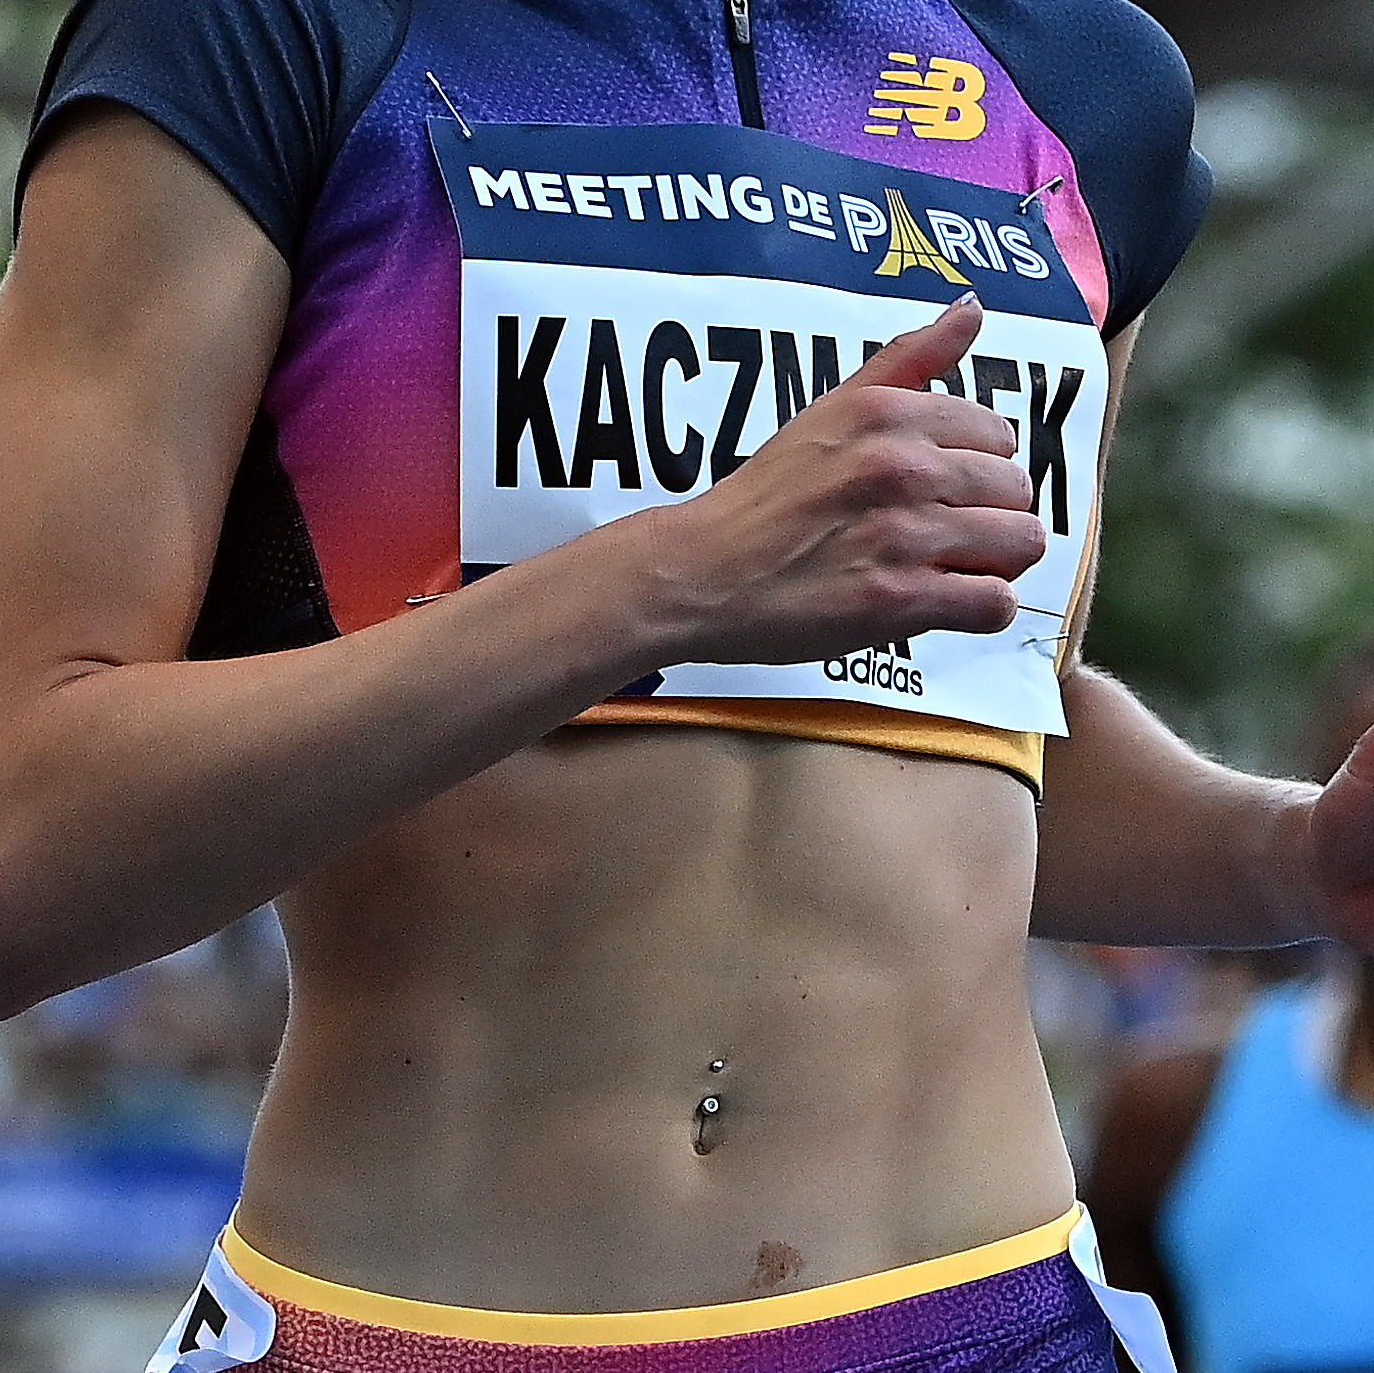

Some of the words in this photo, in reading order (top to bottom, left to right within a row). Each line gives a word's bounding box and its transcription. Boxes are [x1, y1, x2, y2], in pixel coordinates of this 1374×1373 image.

[467, 165, 775, 224] MEETING
[780, 184, 835, 227] DE
[838, 187, 1050, 286] PARIS
[495, 314, 1085, 537] KACZMK
[823, 650, 923, 697] adidas
